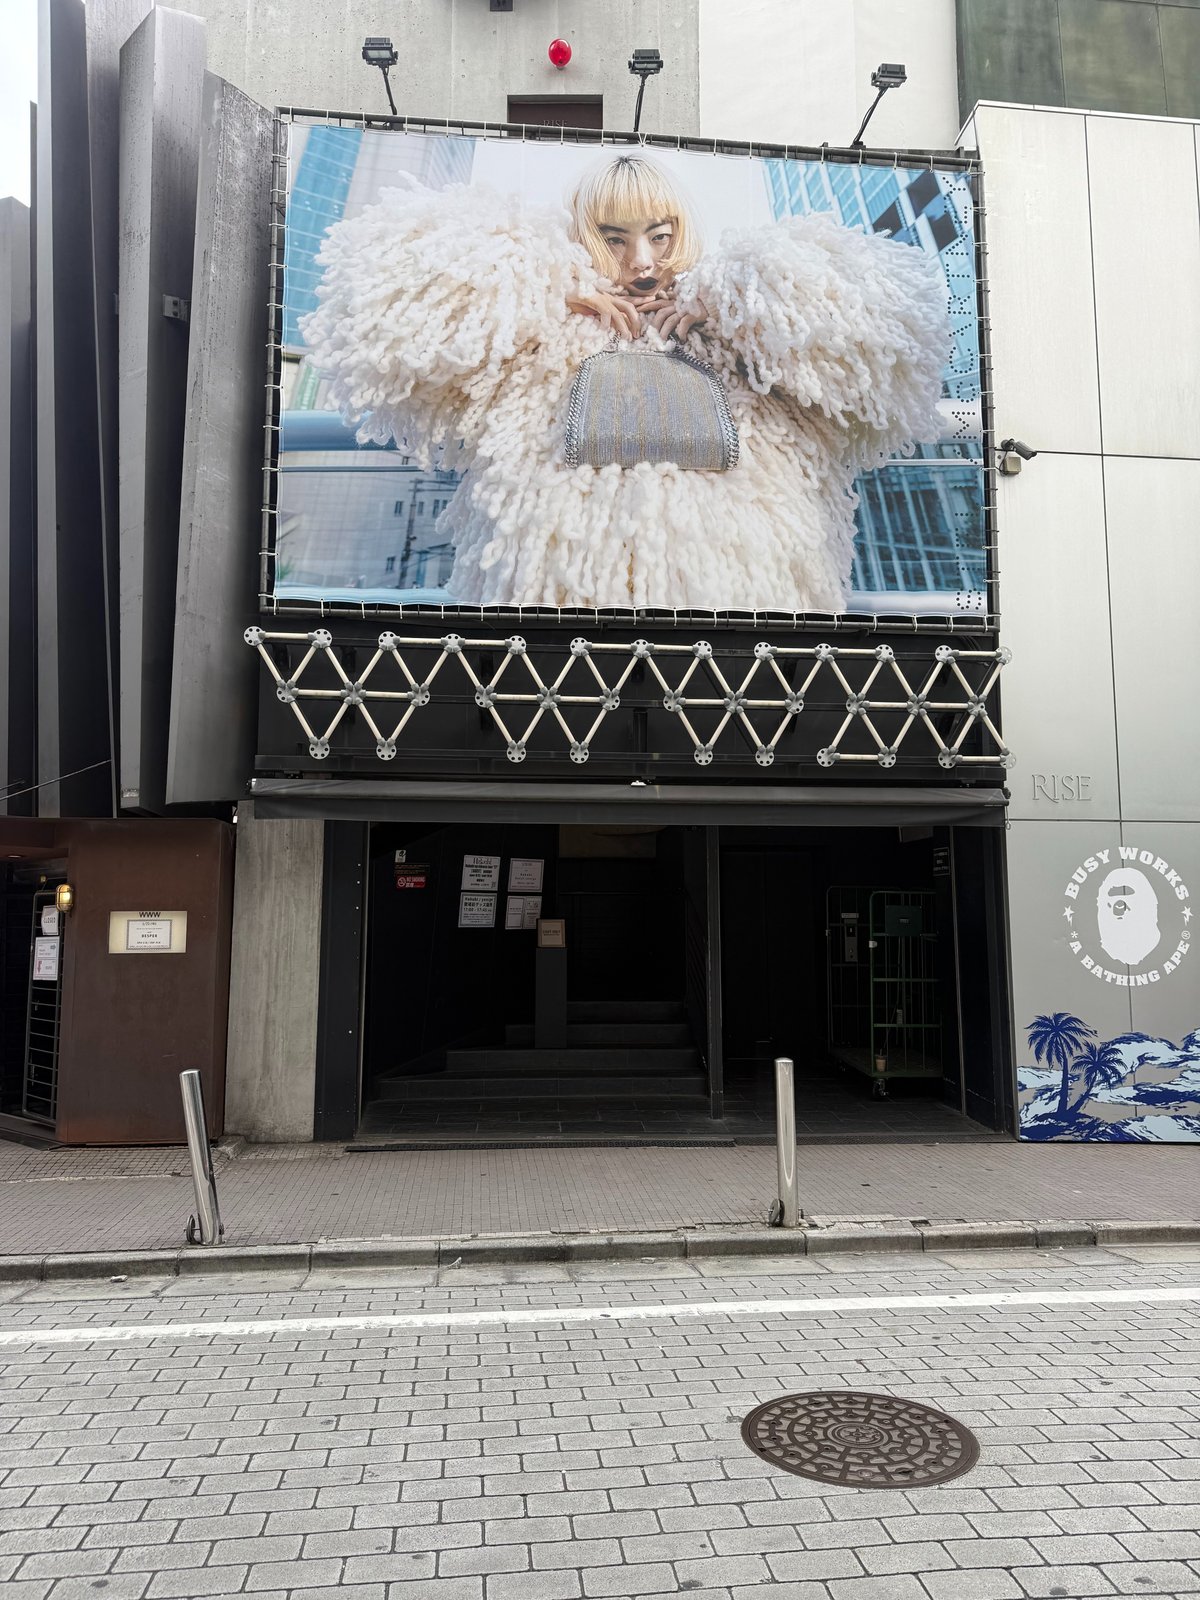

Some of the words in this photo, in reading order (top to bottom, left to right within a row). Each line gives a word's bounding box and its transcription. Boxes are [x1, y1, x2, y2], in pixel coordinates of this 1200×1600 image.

[952, 448, 982, 611] STELLA
[1031, 774, 1092, 803] RISE
[1064, 849, 1110, 900] BUSY
[1118, 846, 1190, 901] WORKS
[1069, 940, 1082, 955] A
[1080, 954, 1161, 987] BATHING
